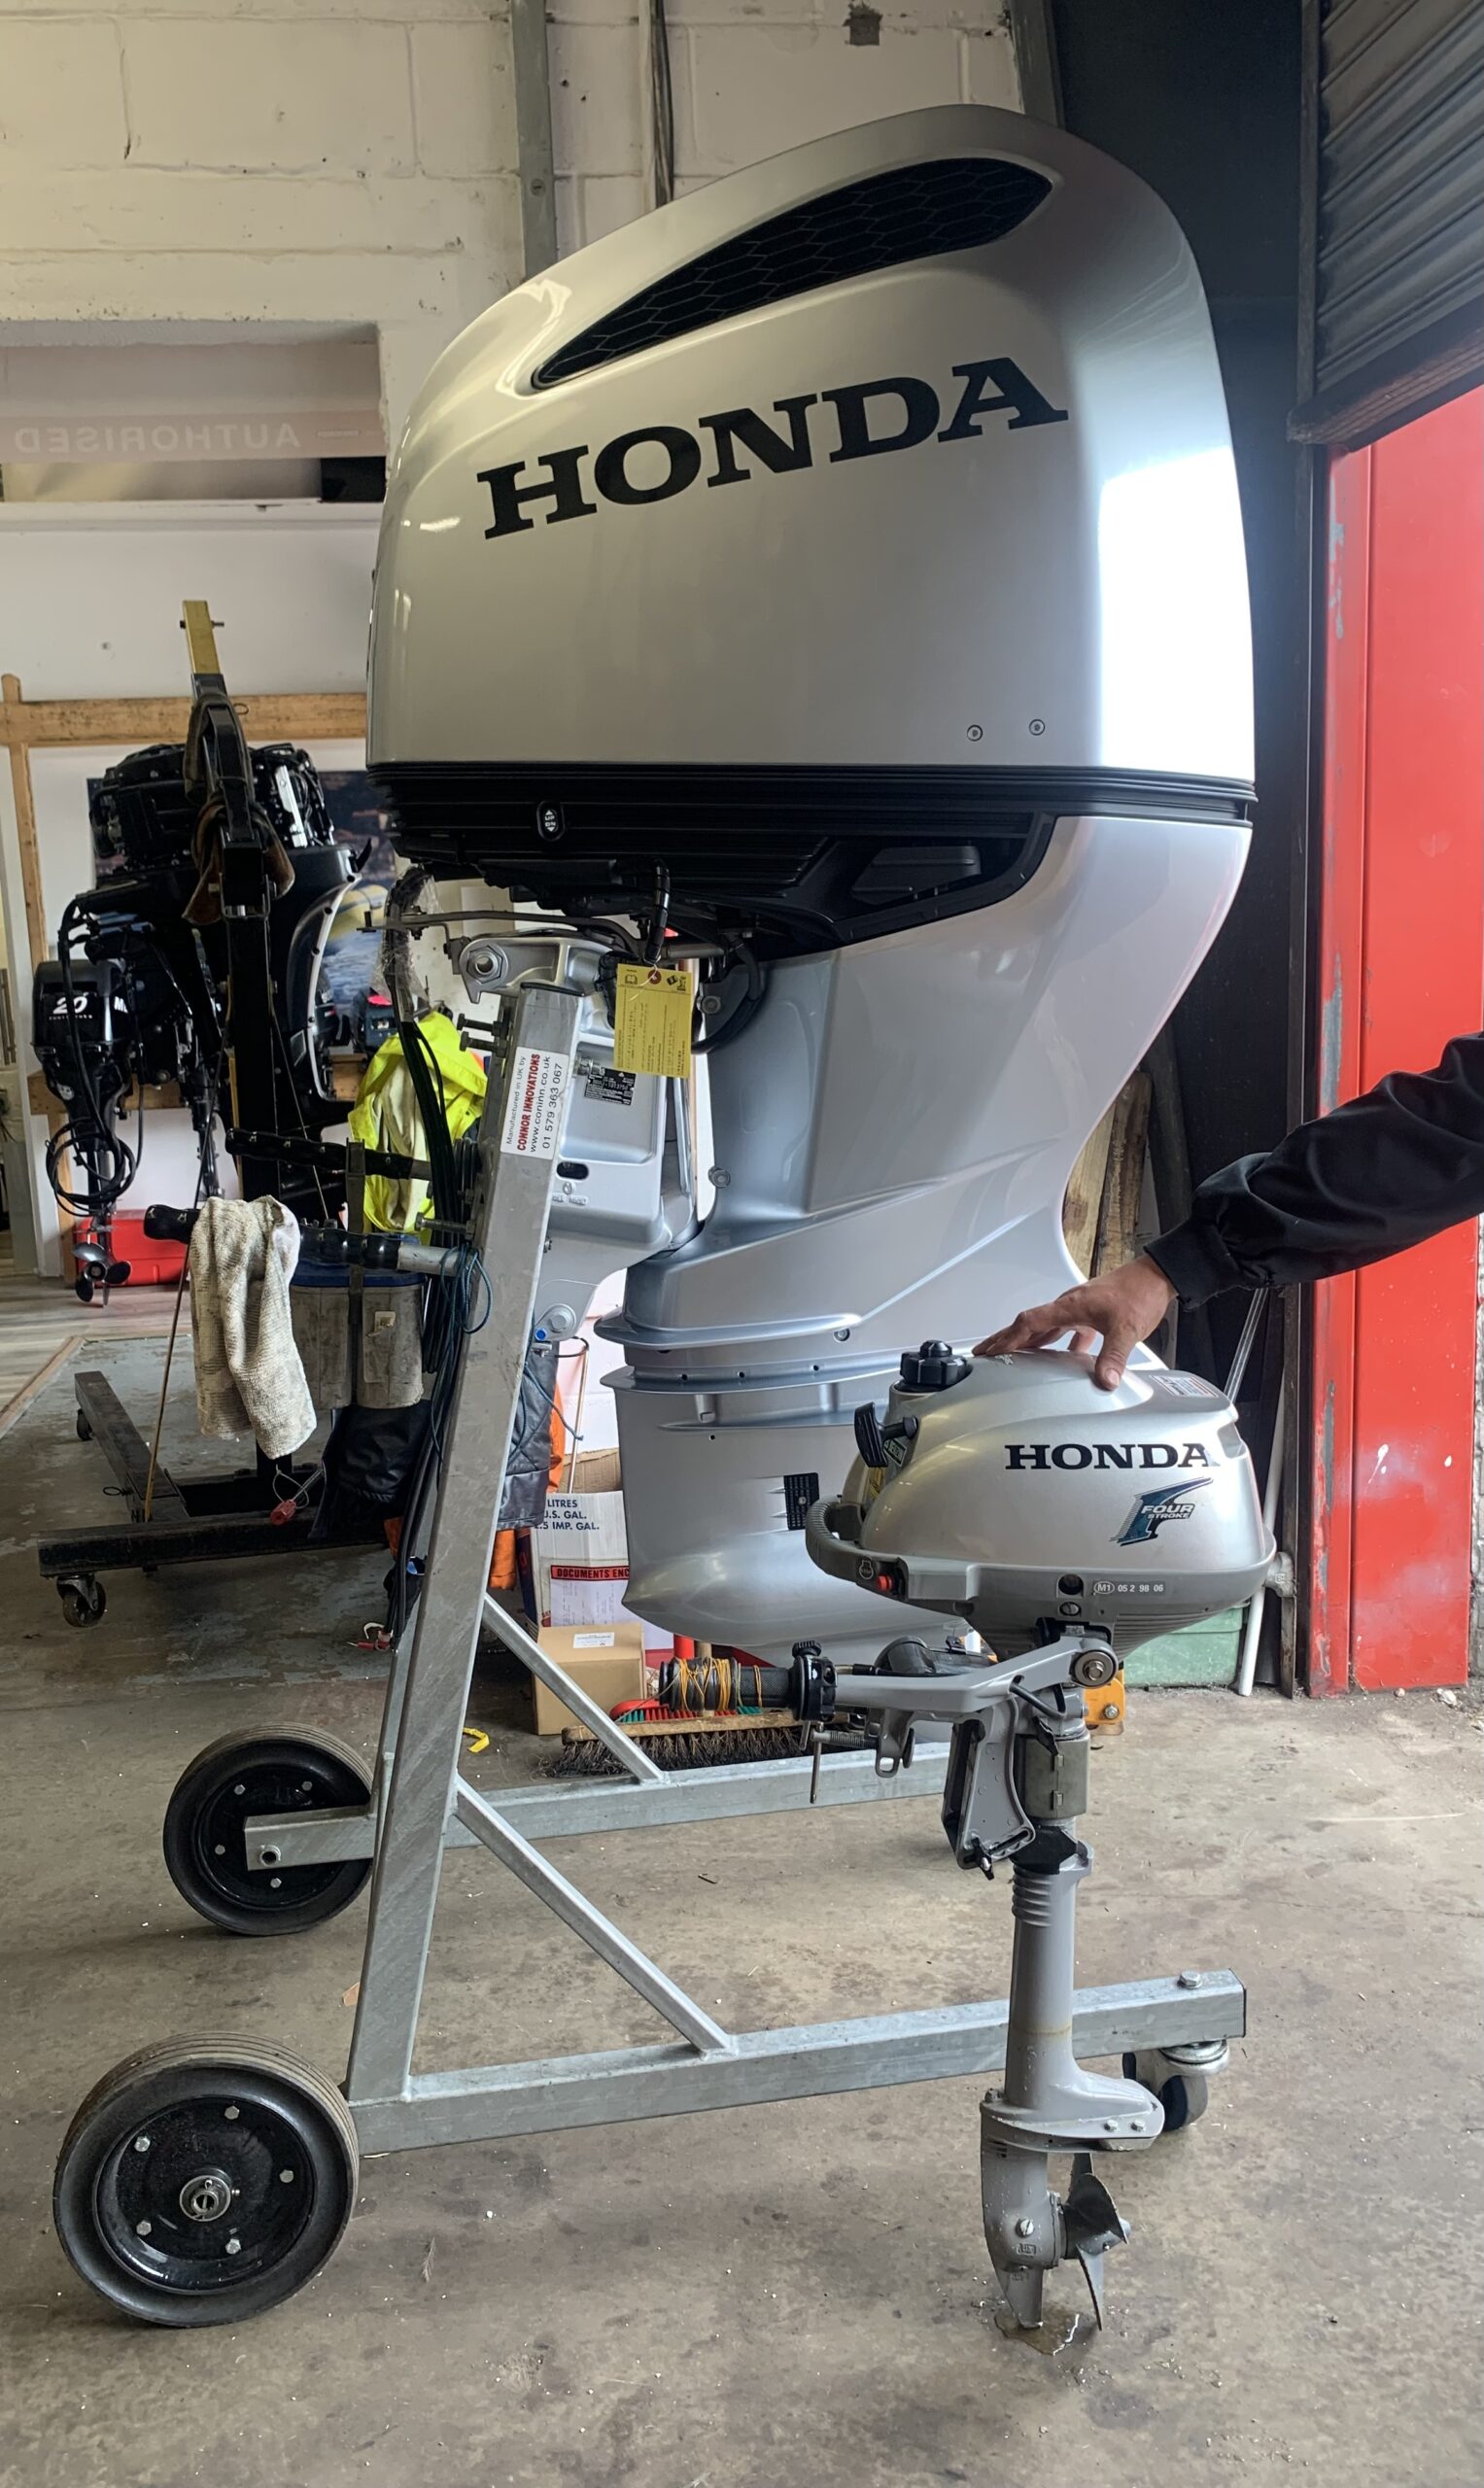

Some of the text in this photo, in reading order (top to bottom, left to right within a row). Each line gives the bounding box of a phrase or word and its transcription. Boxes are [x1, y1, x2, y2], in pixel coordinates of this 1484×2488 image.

[476, 357, 1068, 539] HONDA
[506, 1091, 520, 1144] Manufactured
[517, 1068, 523, 1082] UK
[520, 1056, 526, 1065] by
[517, 1053, 540, 1152] CONNOR INNOVATIONS
[530, 1056, 550, 1153] www.coninn.co.uk
[542, 1063, 563, 1149] 01 579 363 067
[1004, 1442, 1221, 1470] HONDA
[547, 1500, 578, 1508] LITRES
[564, 1510, 587, 1519] GAL.
[1141, 1504, 1194, 1514] FOUR
[552, 1522, 572, 1531] IMP.
[575, 1522, 600, 1531] GAL.
[557, 1568, 610, 1579] DOCUMENTS
